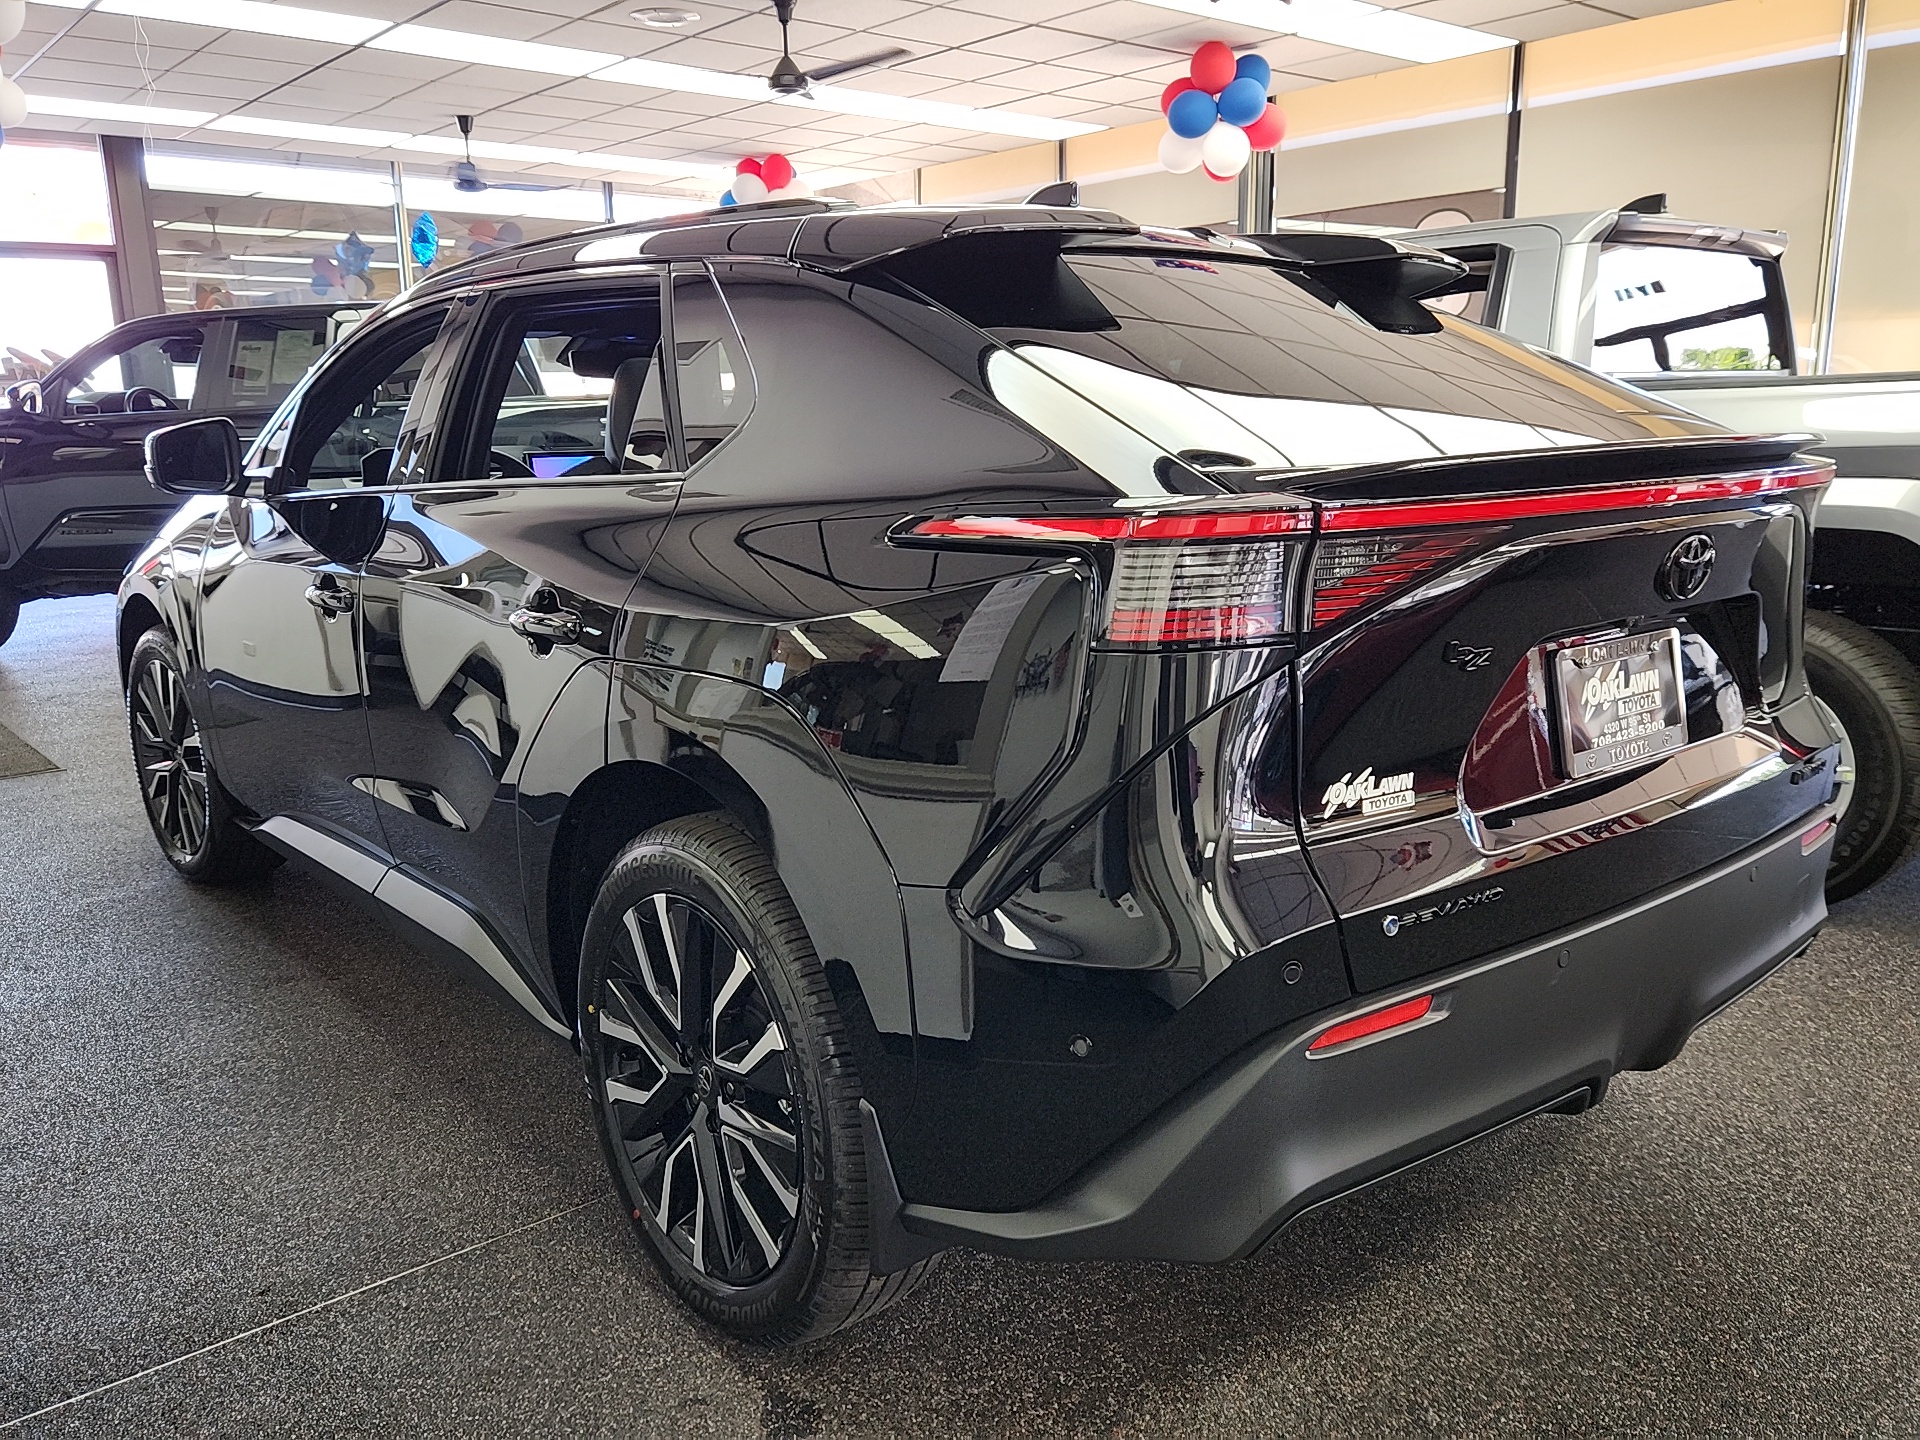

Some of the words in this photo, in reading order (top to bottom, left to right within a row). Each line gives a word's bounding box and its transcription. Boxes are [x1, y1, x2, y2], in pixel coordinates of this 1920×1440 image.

[1622, 694, 1657, 712] TOYOTA
[1592, 720, 1665, 748] 708-423-5200
[1603, 720, 1620, 734] 4320
[1620, 718, 1631, 731] W
[1643, 713, 1652, 724] St
[1608, 740, 1652, 763] TOYOTA
[1369, 794, 1408, 811] TOYOTA
